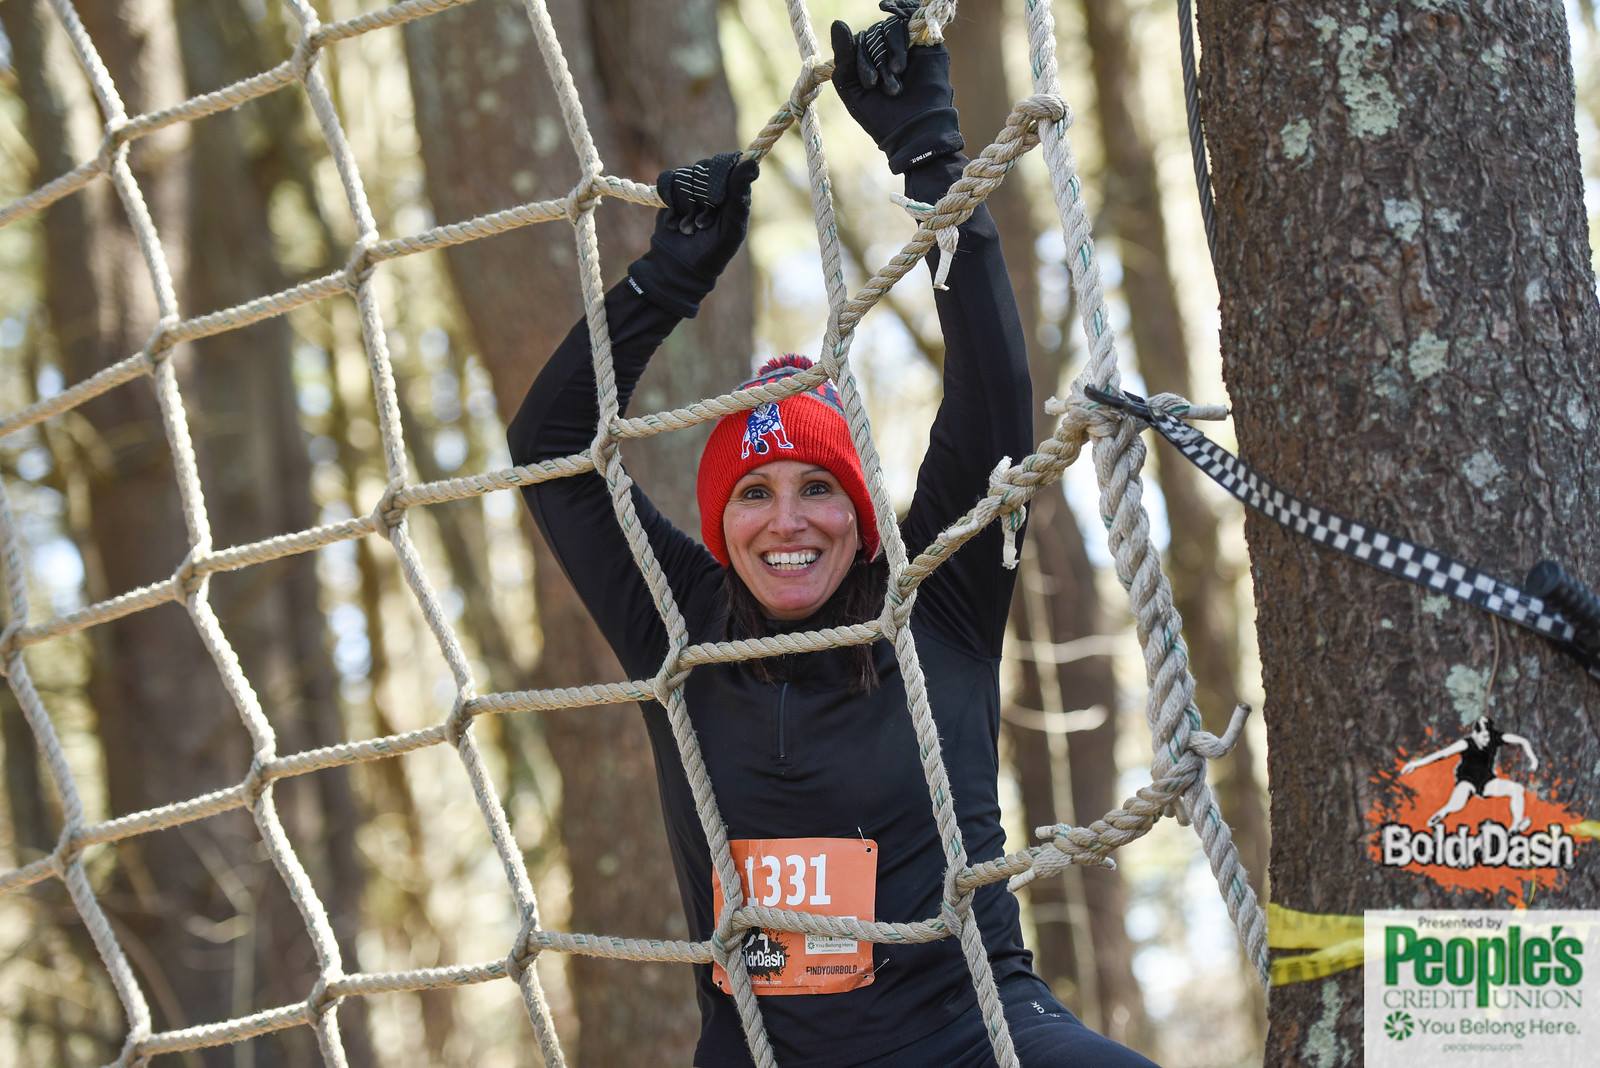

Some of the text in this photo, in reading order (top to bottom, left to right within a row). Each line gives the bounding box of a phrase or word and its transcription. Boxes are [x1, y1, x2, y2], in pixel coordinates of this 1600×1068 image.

[744, 854, 831, 907] 1331
[744, 950, 785, 967] ldrDash
[805, 965, 858, 975] FINDYOURBOLD
